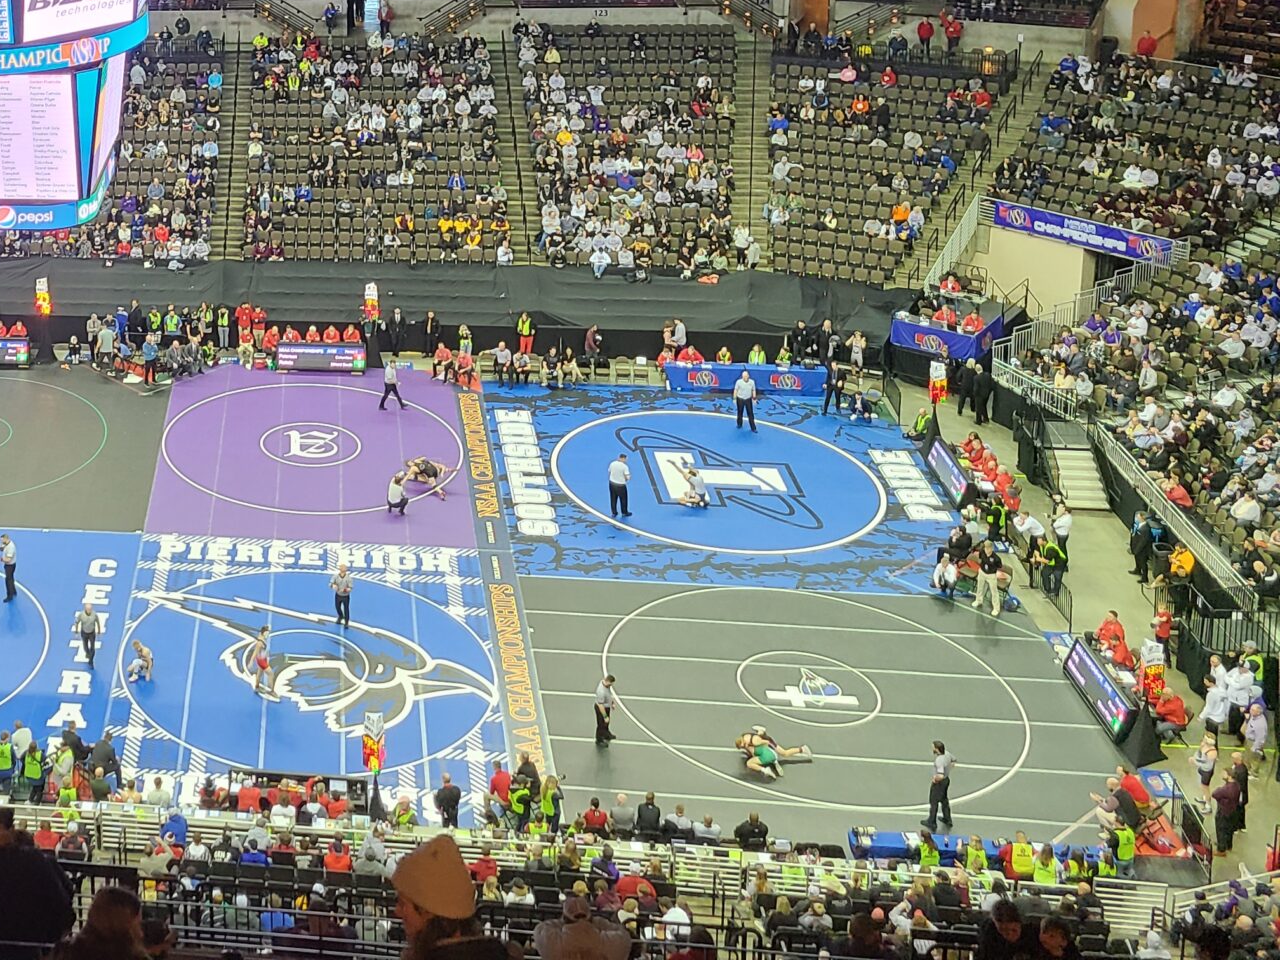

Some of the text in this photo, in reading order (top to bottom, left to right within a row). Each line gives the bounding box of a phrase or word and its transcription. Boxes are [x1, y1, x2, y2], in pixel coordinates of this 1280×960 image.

[18, 210, 54, 225] pepsi
[460, 392, 501, 518] NSAA CHAMPIONSHIPS
[494, 409, 560, 537] SOUTHSIDE
[867, 449, 954, 522] PRIDE
[160, 539, 452, 573] PIERCE HIGH
[489, 583, 537, 722] CHAMPIONSHIPS
